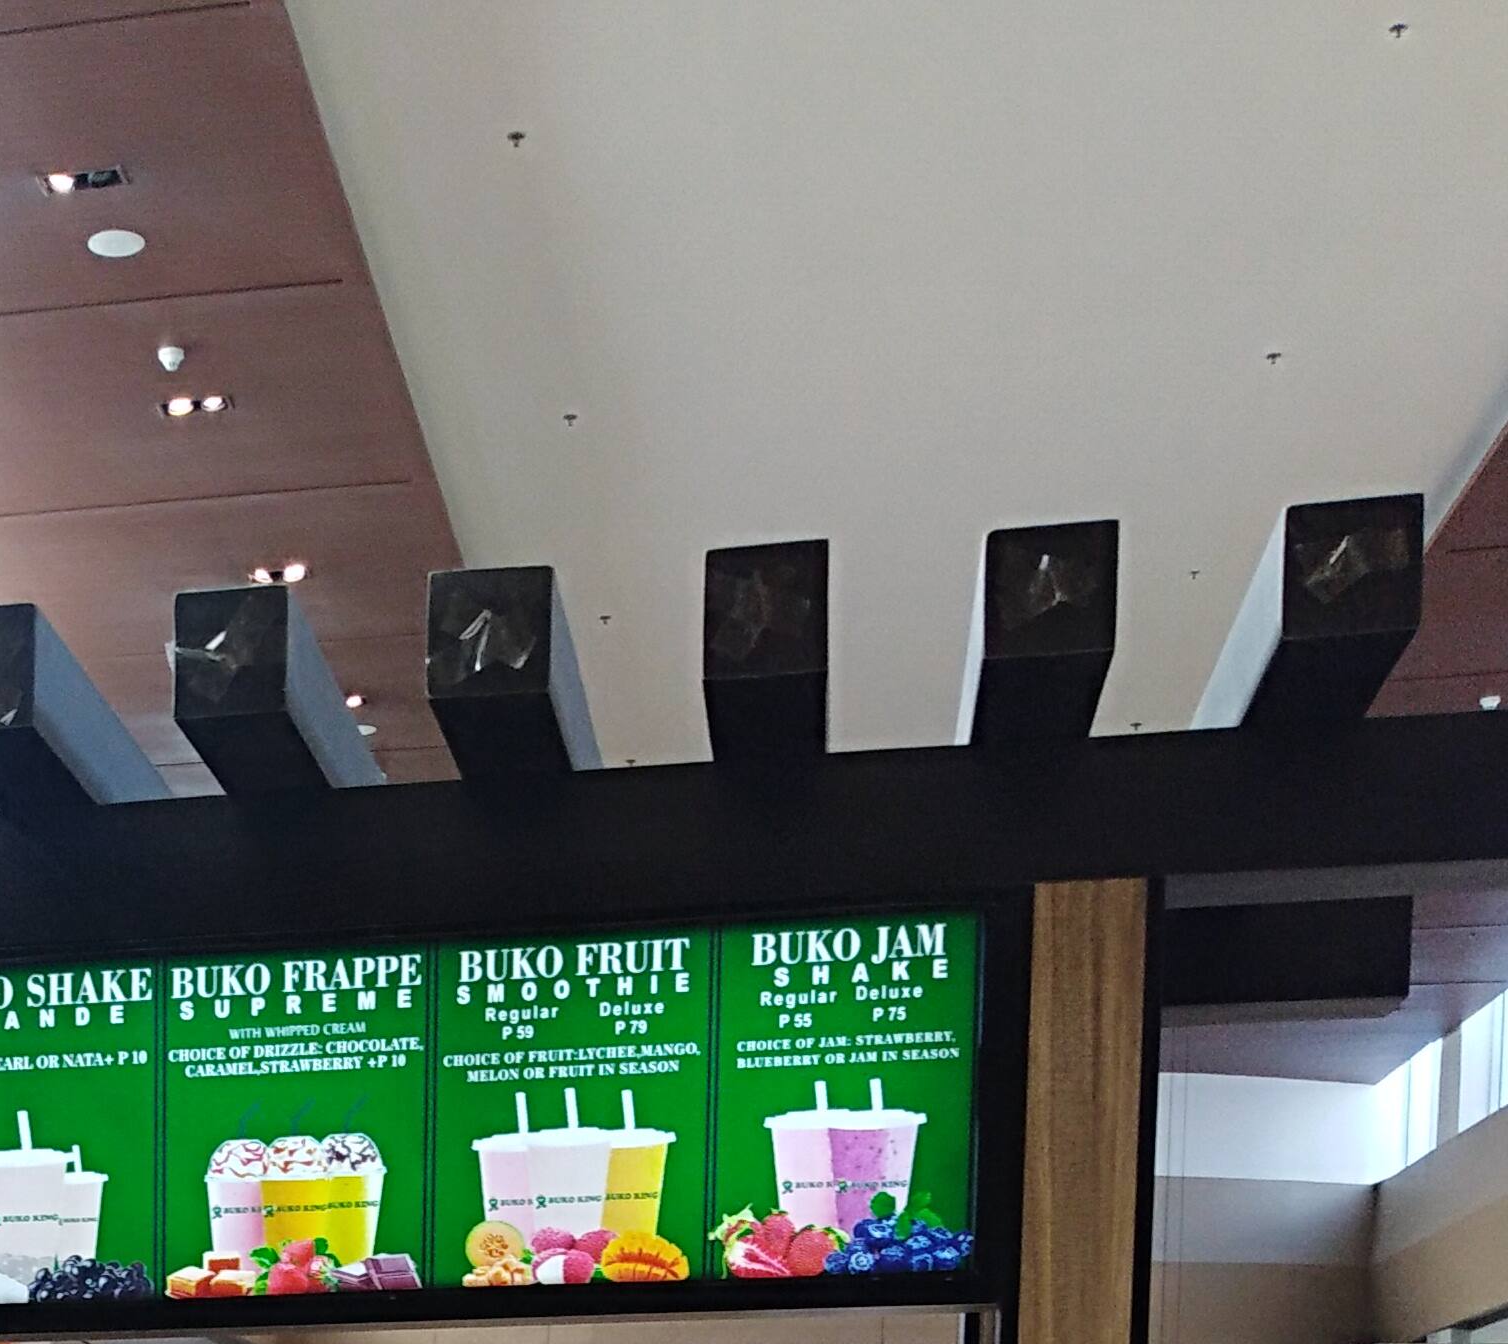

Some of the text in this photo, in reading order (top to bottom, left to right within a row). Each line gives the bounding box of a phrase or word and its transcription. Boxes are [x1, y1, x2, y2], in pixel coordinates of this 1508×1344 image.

[752, 923, 947, 966] BUKO JAM
[458, 938, 690, 983] BUKO FRUIT
[171, 954, 422, 999] BUKO FRAPPE
[774, 959, 948, 987] SHAKE
[26, 968, 153, 1007] SHAKE
[457, 973, 690, 1005] SMOOTHIE
[760, 985, 923, 1009] Regular Deluxe
[180, 989, 412, 1020] SUPREME
[485, 1002, 664, 1024] Regular Deluxe
[229, 1022, 367, 1040] WITH WHIPPED CREAM
[736, 1031, 956, 1052] CHOICE OF JAM: STRAWBERRY,
[36, 1054, 60, 1069] OR
[168, 1037, 424, 1062] CHOICE OF DRIZZLE: CHOCOLATE,
[392, 1054, 406, 1067] 10
[443, 1053, 500, 1067] CHOICE
[504, 1051, 524, 1065] OF
[736, 1047, 960, 1069] BLUEBERRY OR JAM IN SEASON
[467, 1060, 680, 1083] MELON OR FRUIT IN SEASON
